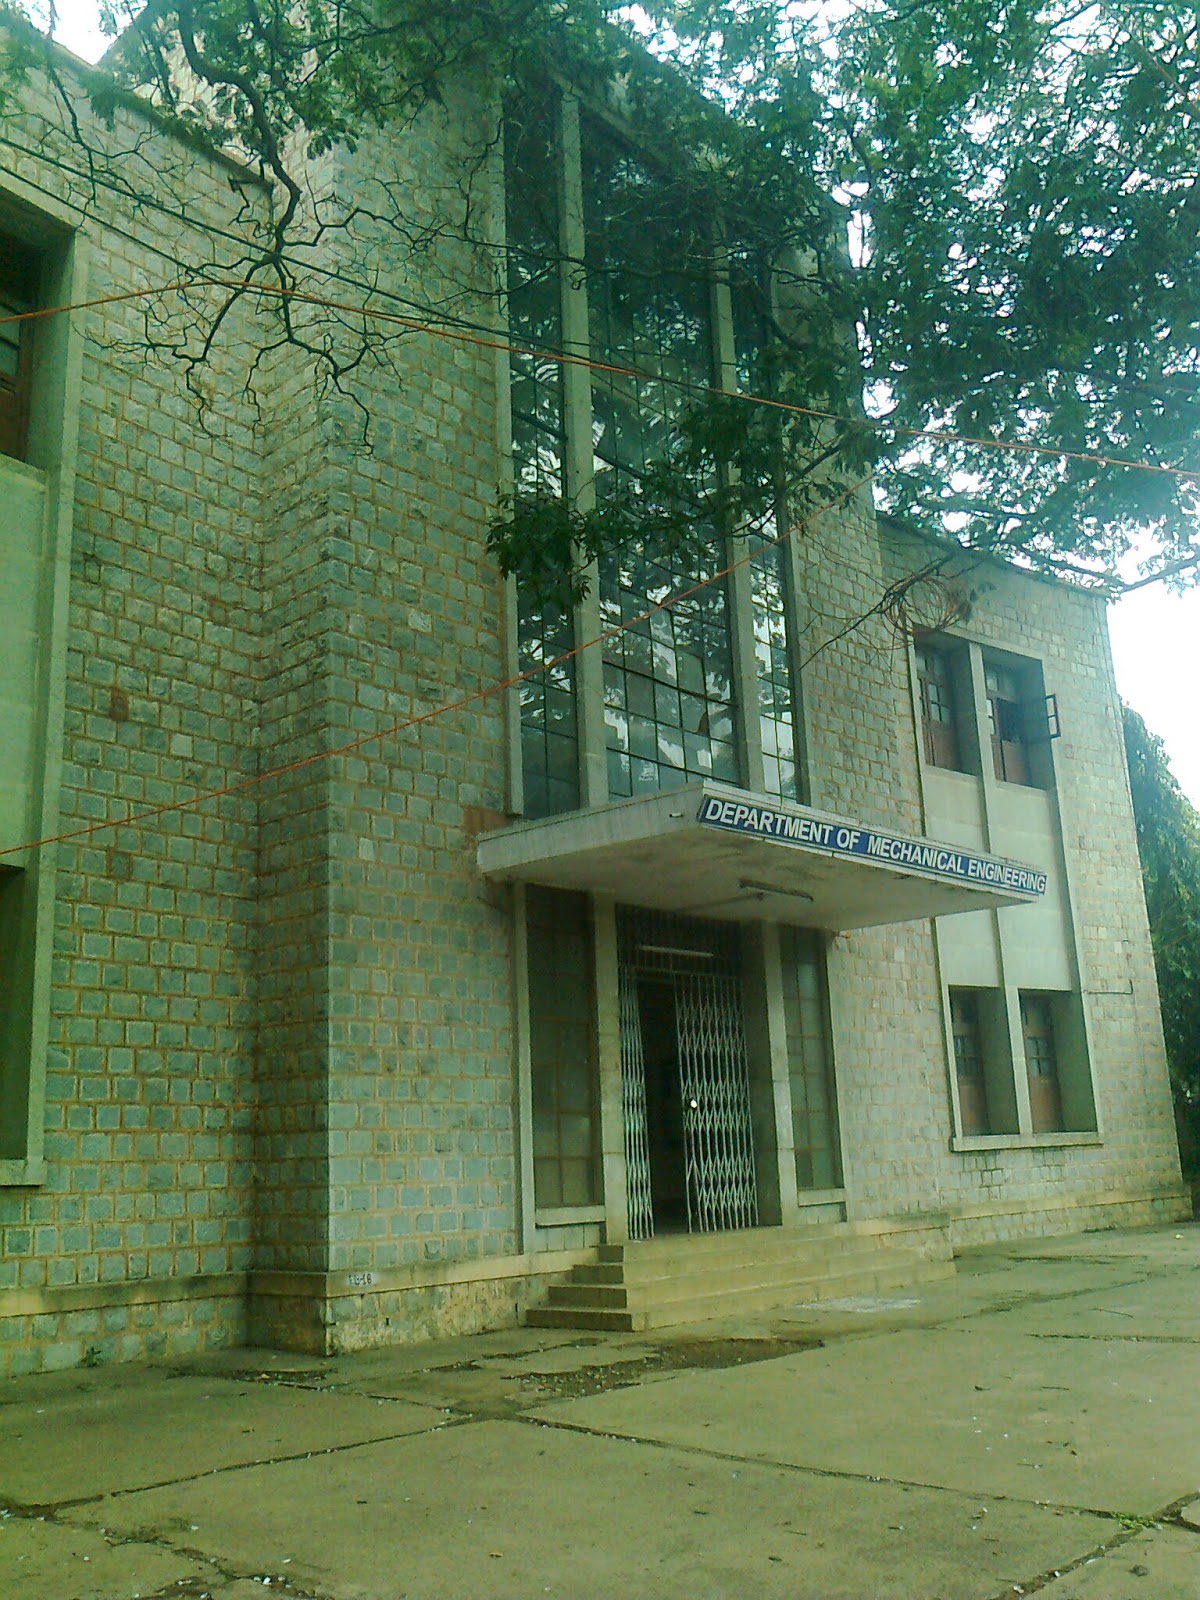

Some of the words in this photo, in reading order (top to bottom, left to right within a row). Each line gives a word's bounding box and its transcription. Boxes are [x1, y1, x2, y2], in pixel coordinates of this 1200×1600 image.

[705, 799, 833, 845] DEPARTMENT
[836, 828, 860, 850] OF
[867, 835, 965, 875] MECHANICAL
[967, 859, 1046, 892] ENGINEERING
